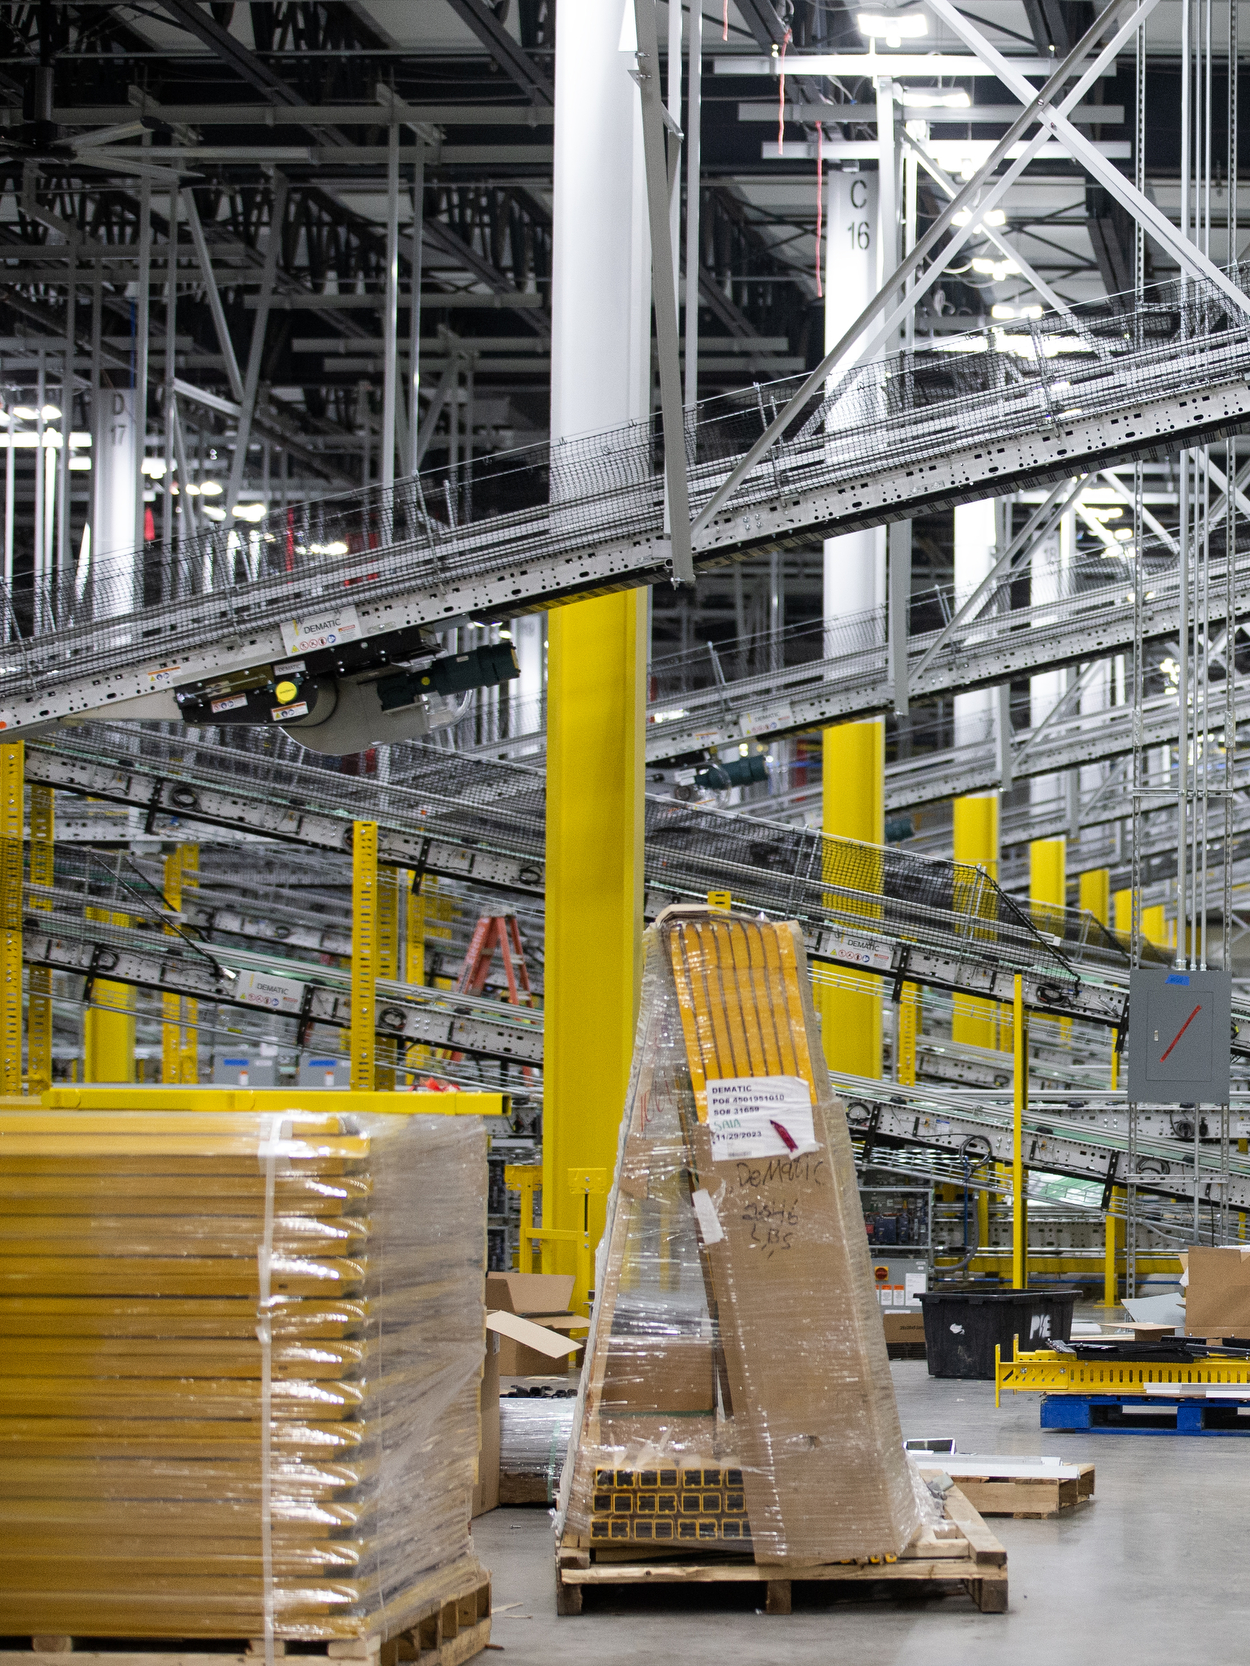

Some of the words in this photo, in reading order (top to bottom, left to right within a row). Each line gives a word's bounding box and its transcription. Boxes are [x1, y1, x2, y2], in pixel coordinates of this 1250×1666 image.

[850, 179, 867, 209] C
[847, 221, 870, 251] 16
[112, 393, 125, 416] D
[304, 618, 342, 634] DEMATIC
[848, 939, 880, 952] DEMATIC
[257, 982, 289, 995] DEMATIC
[711, 1085, 752, 1094] DEMATIC
[712, 1097, 731, 1105] PO#
[716, 1131, 763, 1141] 11/29/2023
